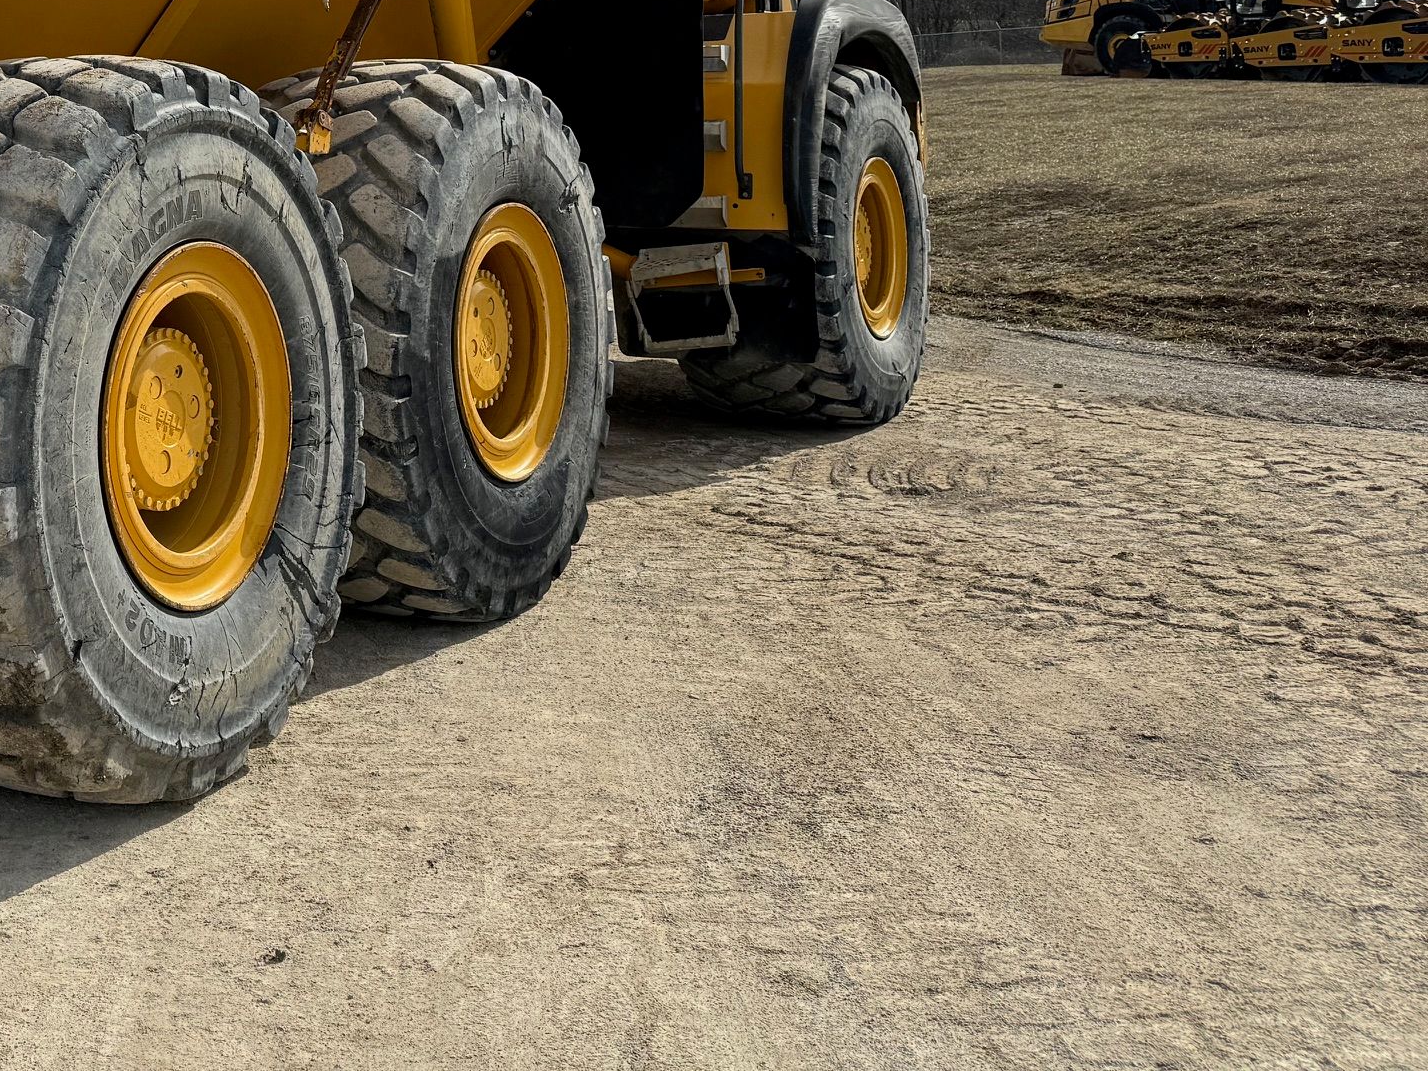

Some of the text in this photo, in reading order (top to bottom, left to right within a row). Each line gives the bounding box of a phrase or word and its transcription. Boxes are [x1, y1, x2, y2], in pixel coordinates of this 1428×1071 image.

[1150, 42, 1172, 51] SANY
[1341, 38, 1372, 47] SANY
[1243, 45, 1270, 54] SANY
[109, 190, 203, 303] MAGNA
